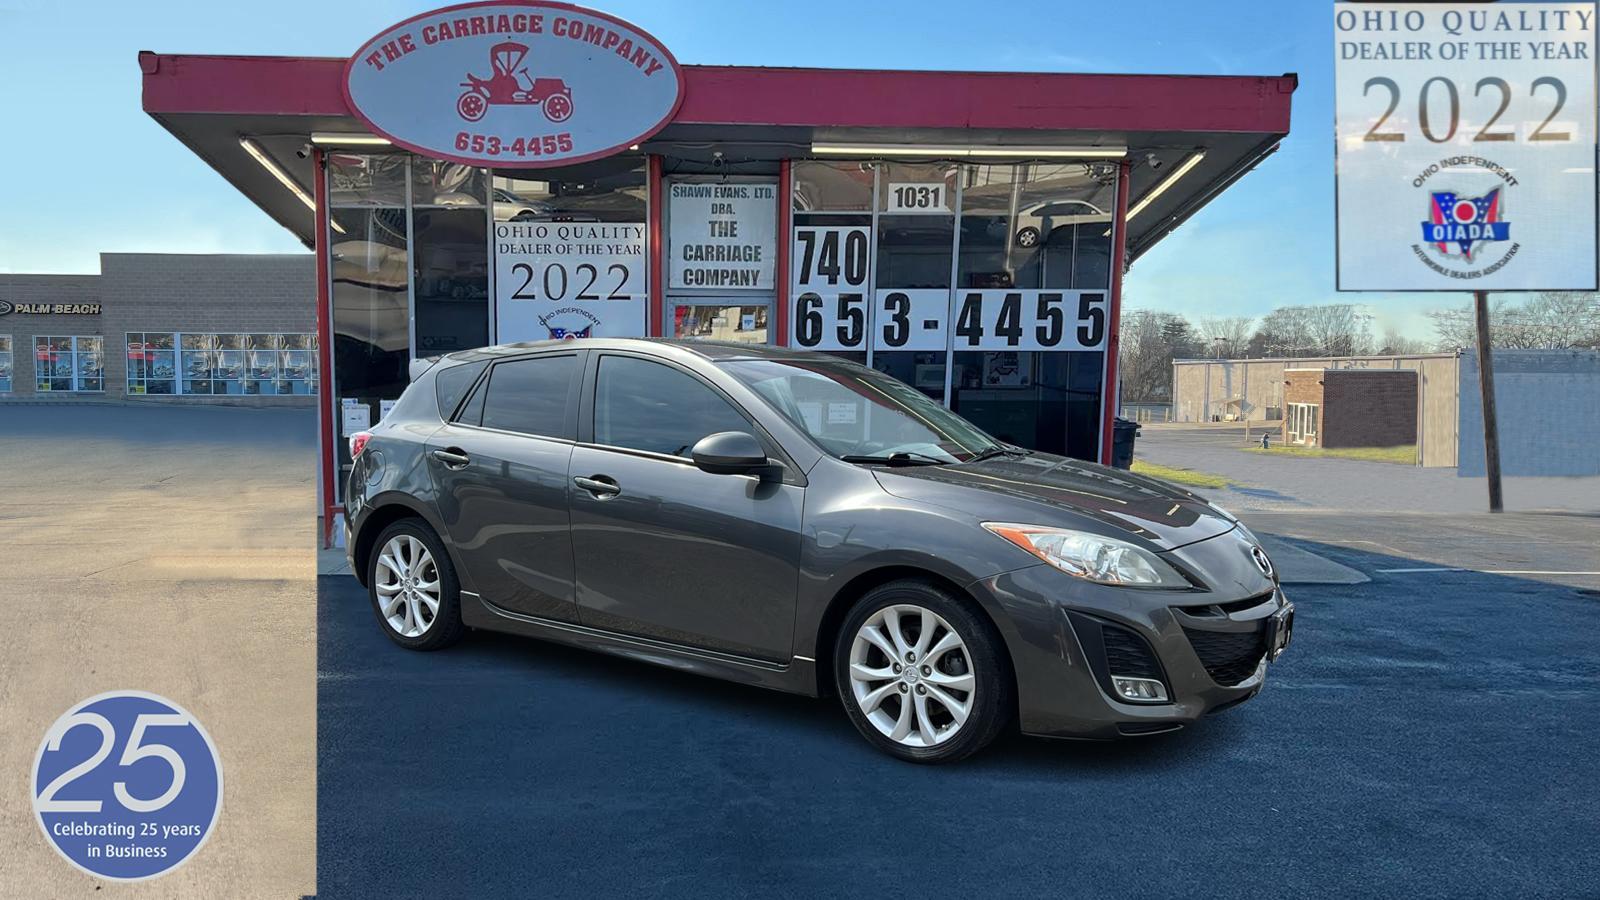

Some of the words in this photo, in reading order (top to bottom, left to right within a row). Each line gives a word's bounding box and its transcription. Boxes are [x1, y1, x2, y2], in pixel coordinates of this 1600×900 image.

[1336, 10, 1425, 31] OHIO
[1442, 10, 1593, 36] QUALITY
[366, 34, 416, 72] THE
[422, 15, 543, 46] CARRIAGE
[553, 17, 664, 77] COMPANY
[1341, 42, 1432, 60] DEALER
[1439, 42, 1469, 60] OF
[1475, 42, 1522, 60] THE
[1528, 42, 1589, 60] YEAR
[1363, 76, 1571, 143] 2022
[454, 132, 573, 157] 653-4455
[1413, 164, 1439, 188] OHIO
[1440, 156, 1519, 187] INDEPENDENT
[672, 186, 712, 199] SHAWN
[754, 187, 775, 199] LTD.
[894, 187, 940, 208] 1031
[711, 203, 736, 215] DBA.
[497, 226, 549, 239] OHIO
[558, 226, 644, 241] QUALITY
[708, 221, 738, 237] THE
[1432, 224, 1496, 240] OIADA
[500, 244, 551, 255] DEALER
[555, 244, 573, 255] OF
[576, 244, 602, 255] THE
[607, 244, 641, 255] YEAR
[683, 245, 762, 262] CARRIAGE
[797, 230, 867, 286] 740
[1411, 244, 1449, 277] AUTOMOBILE
[1450, 271, 1482, 280] DEALERS
[1482, 242, 1520, 275] ASSOCIATION
[511, 263, 631, 301] 2022
[683, 268, 760, 286] COMPANY
[15, 304, 50, 314] PALM
[55, 304, 100, 314] BEACH
[555, 307, 600, 326] INDEPENDENT
